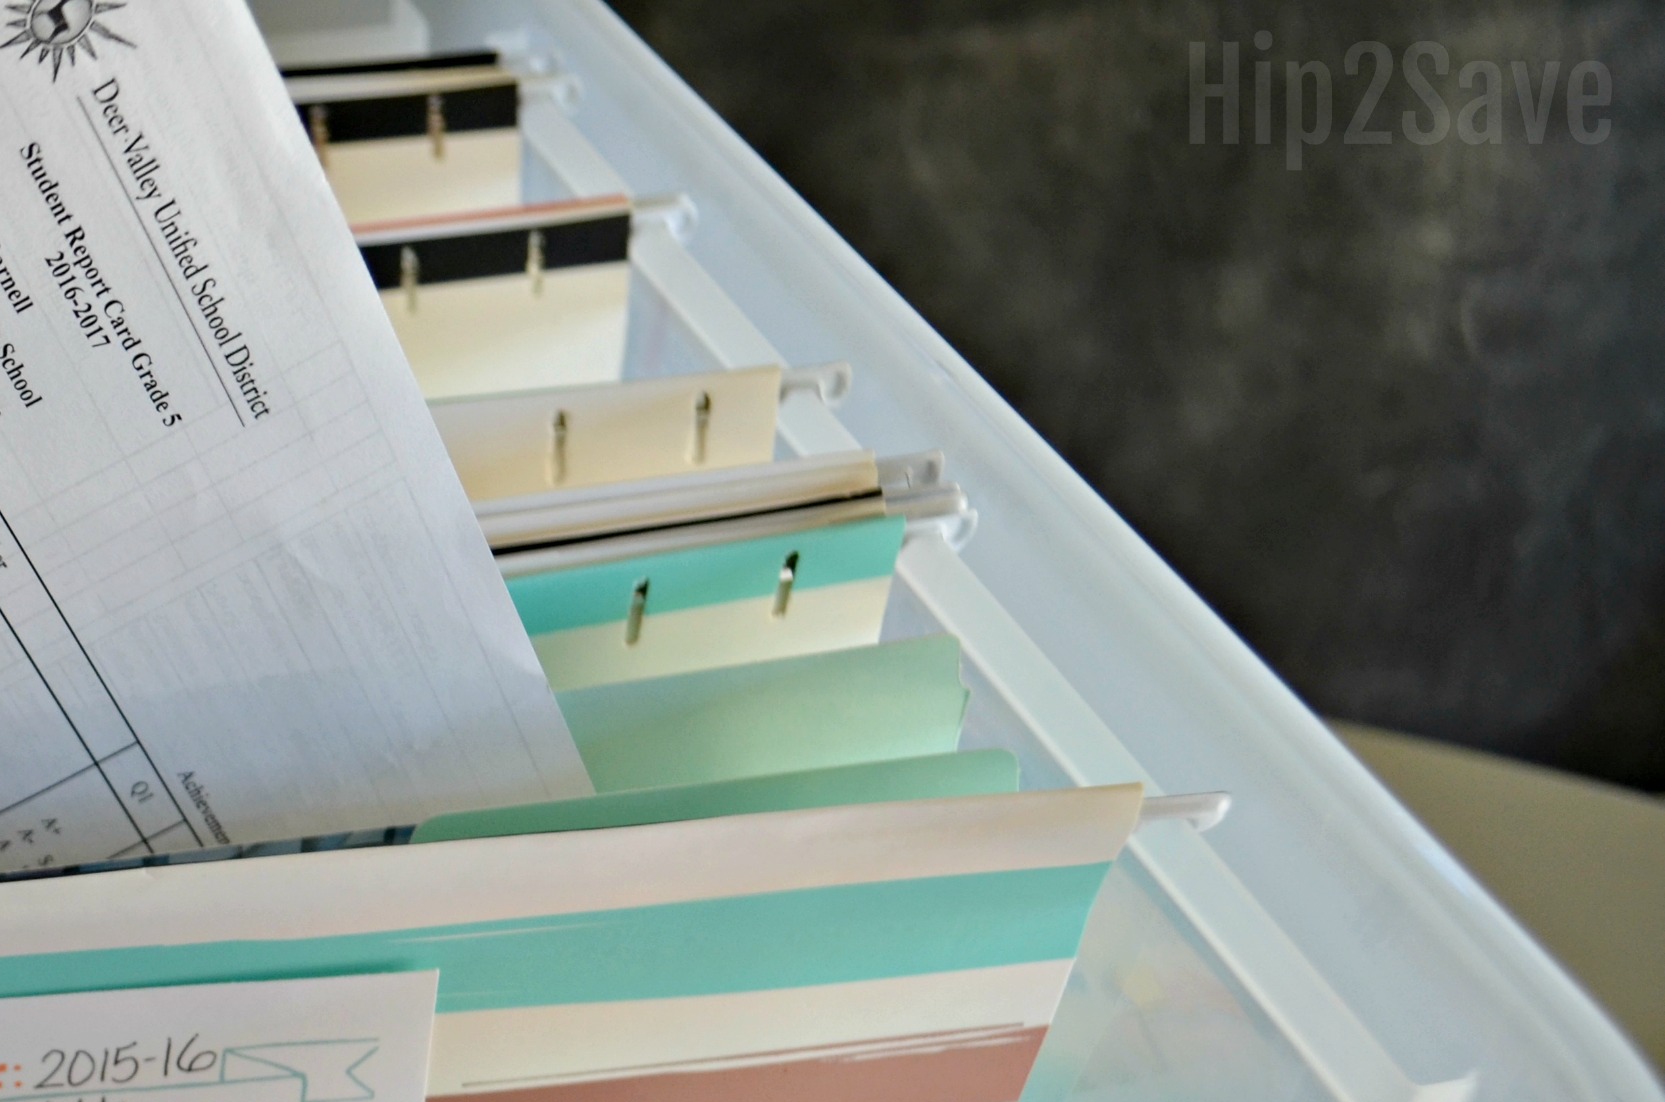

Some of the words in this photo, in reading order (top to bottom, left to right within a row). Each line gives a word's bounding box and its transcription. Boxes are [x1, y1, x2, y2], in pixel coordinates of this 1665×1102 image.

[19, 141, 74, 226] Student
[64, 225, 112, 298] Report
[103, 299, 142, 352] Card
[131, 352, 170, 413] Grade
[162, 413, 183, 427] 5
[91, 77, 130, 136] Deer
[123, 131, 162, 200] Valley
[153, 198, 209, 281] Unified
[191, 277, 242, 348] School
[223, 344, 270, 420] District
[44, 250, 111, 348] 2016-2017
[131, 781, 154, 803] Q1
[177, 770, 230, 844] Achievemen
[33, 1033, 219, 1090] 2015-16
